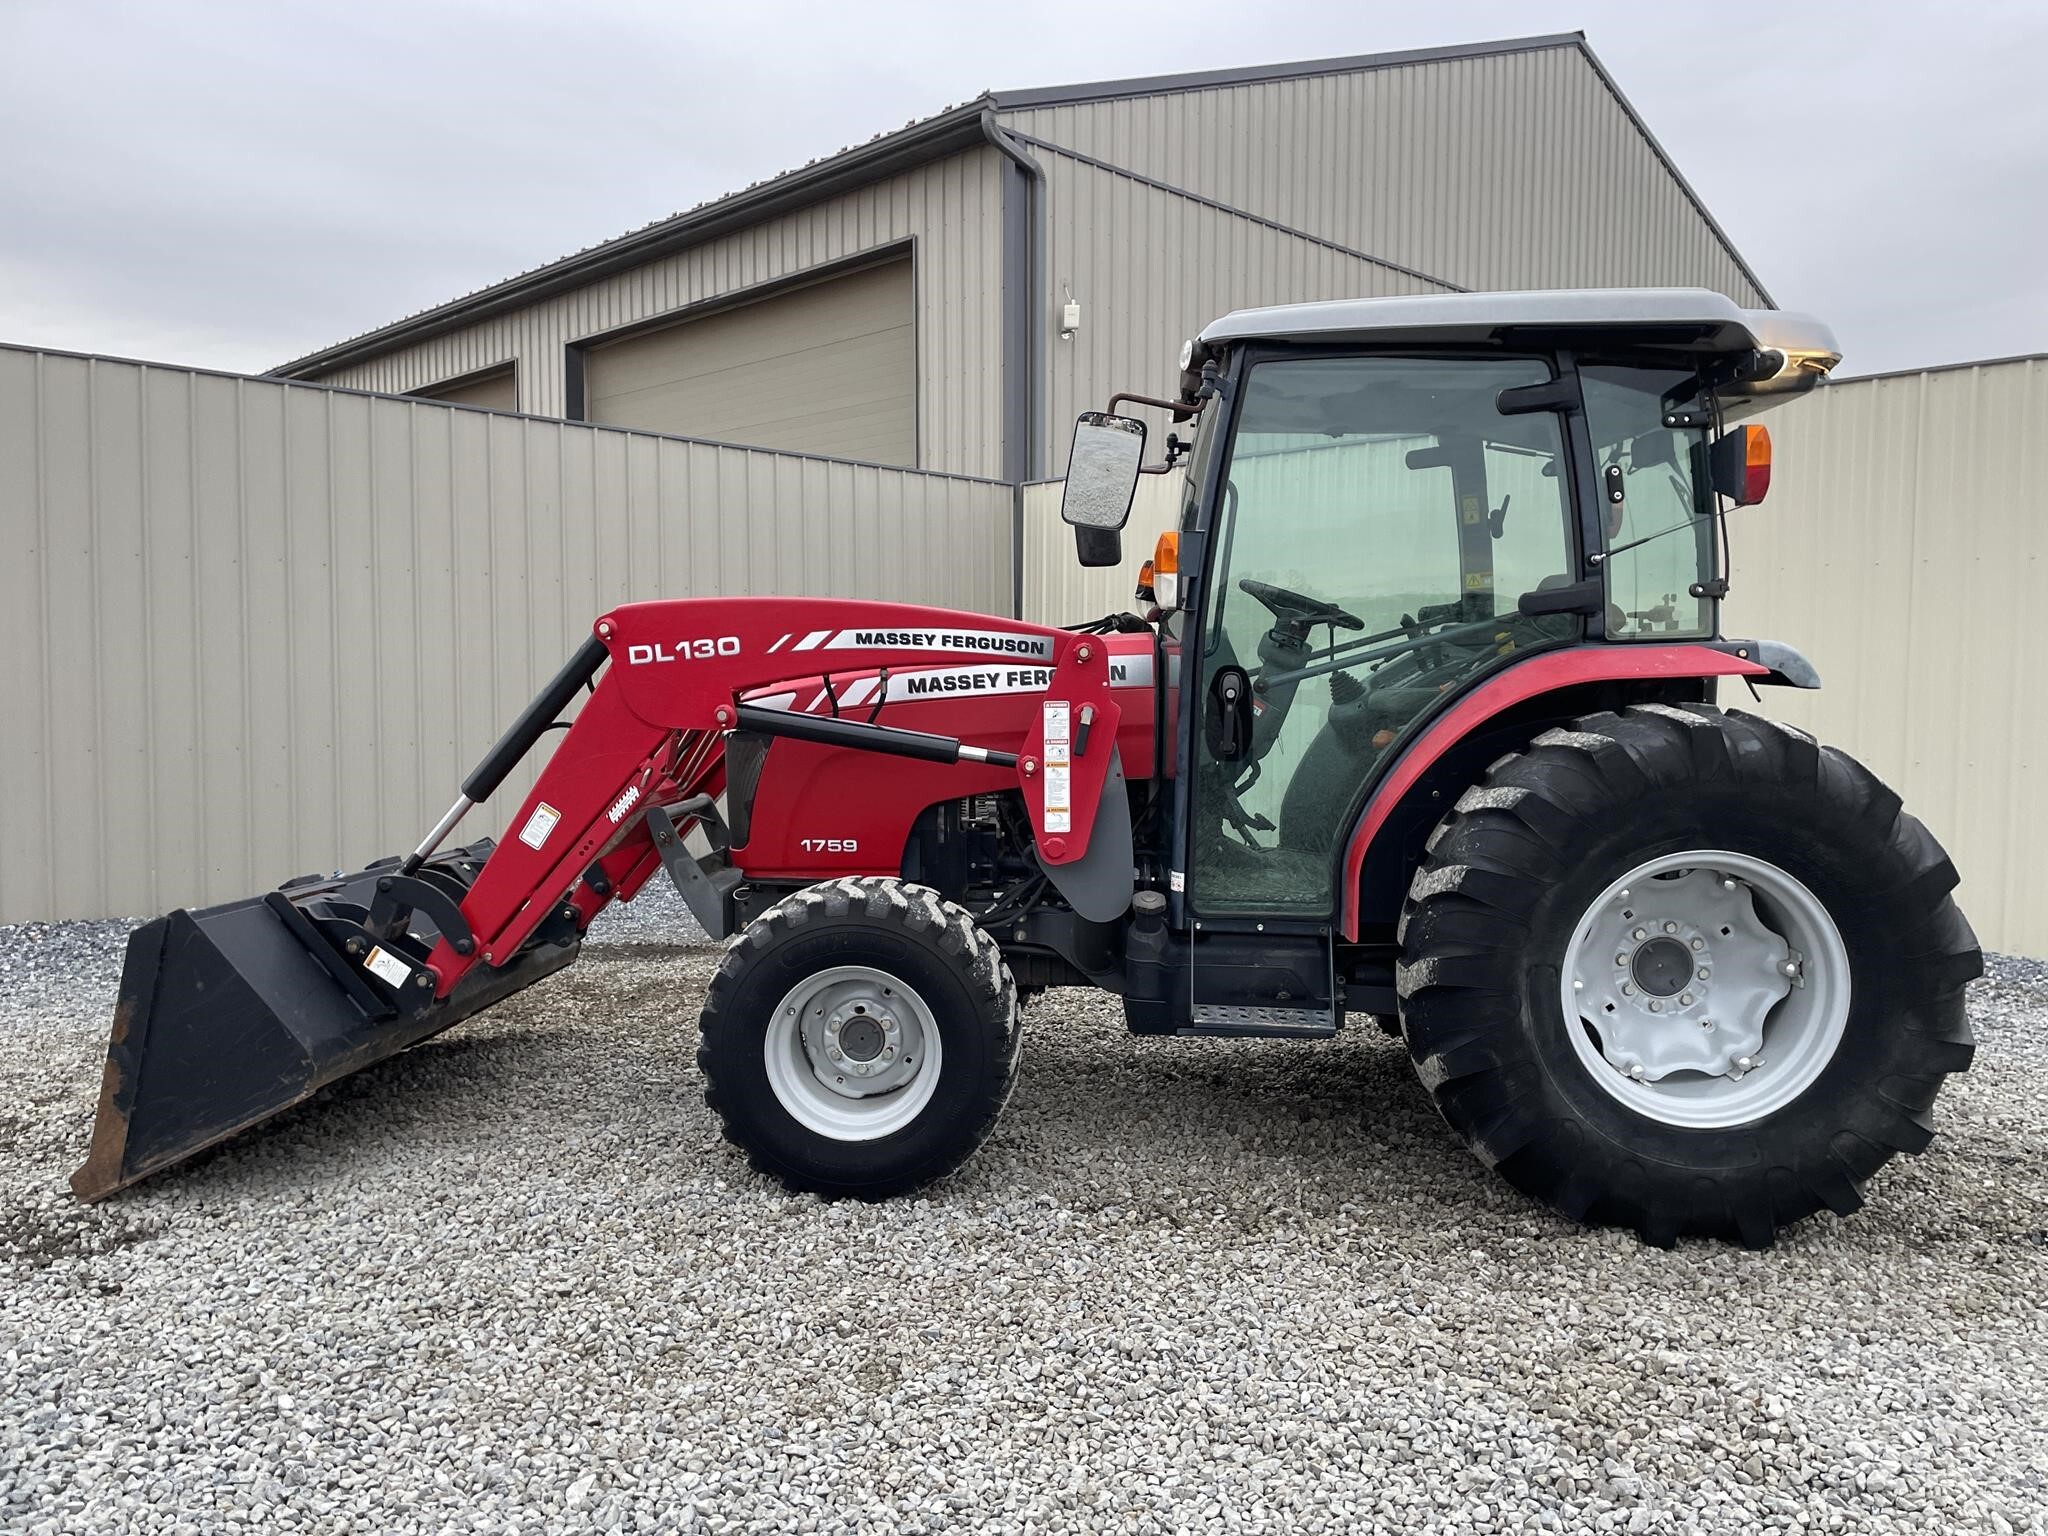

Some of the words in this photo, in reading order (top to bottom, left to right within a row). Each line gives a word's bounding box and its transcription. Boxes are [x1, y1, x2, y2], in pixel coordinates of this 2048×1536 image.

[628, 636, 740, 665] DL130
[855, 632, 936, 646] MASSEY
[941, 634, 1045, 654] FERGUSON
[907, 672, 1001, 694] MASSEY
[800, 839, 858, 853] 1759
